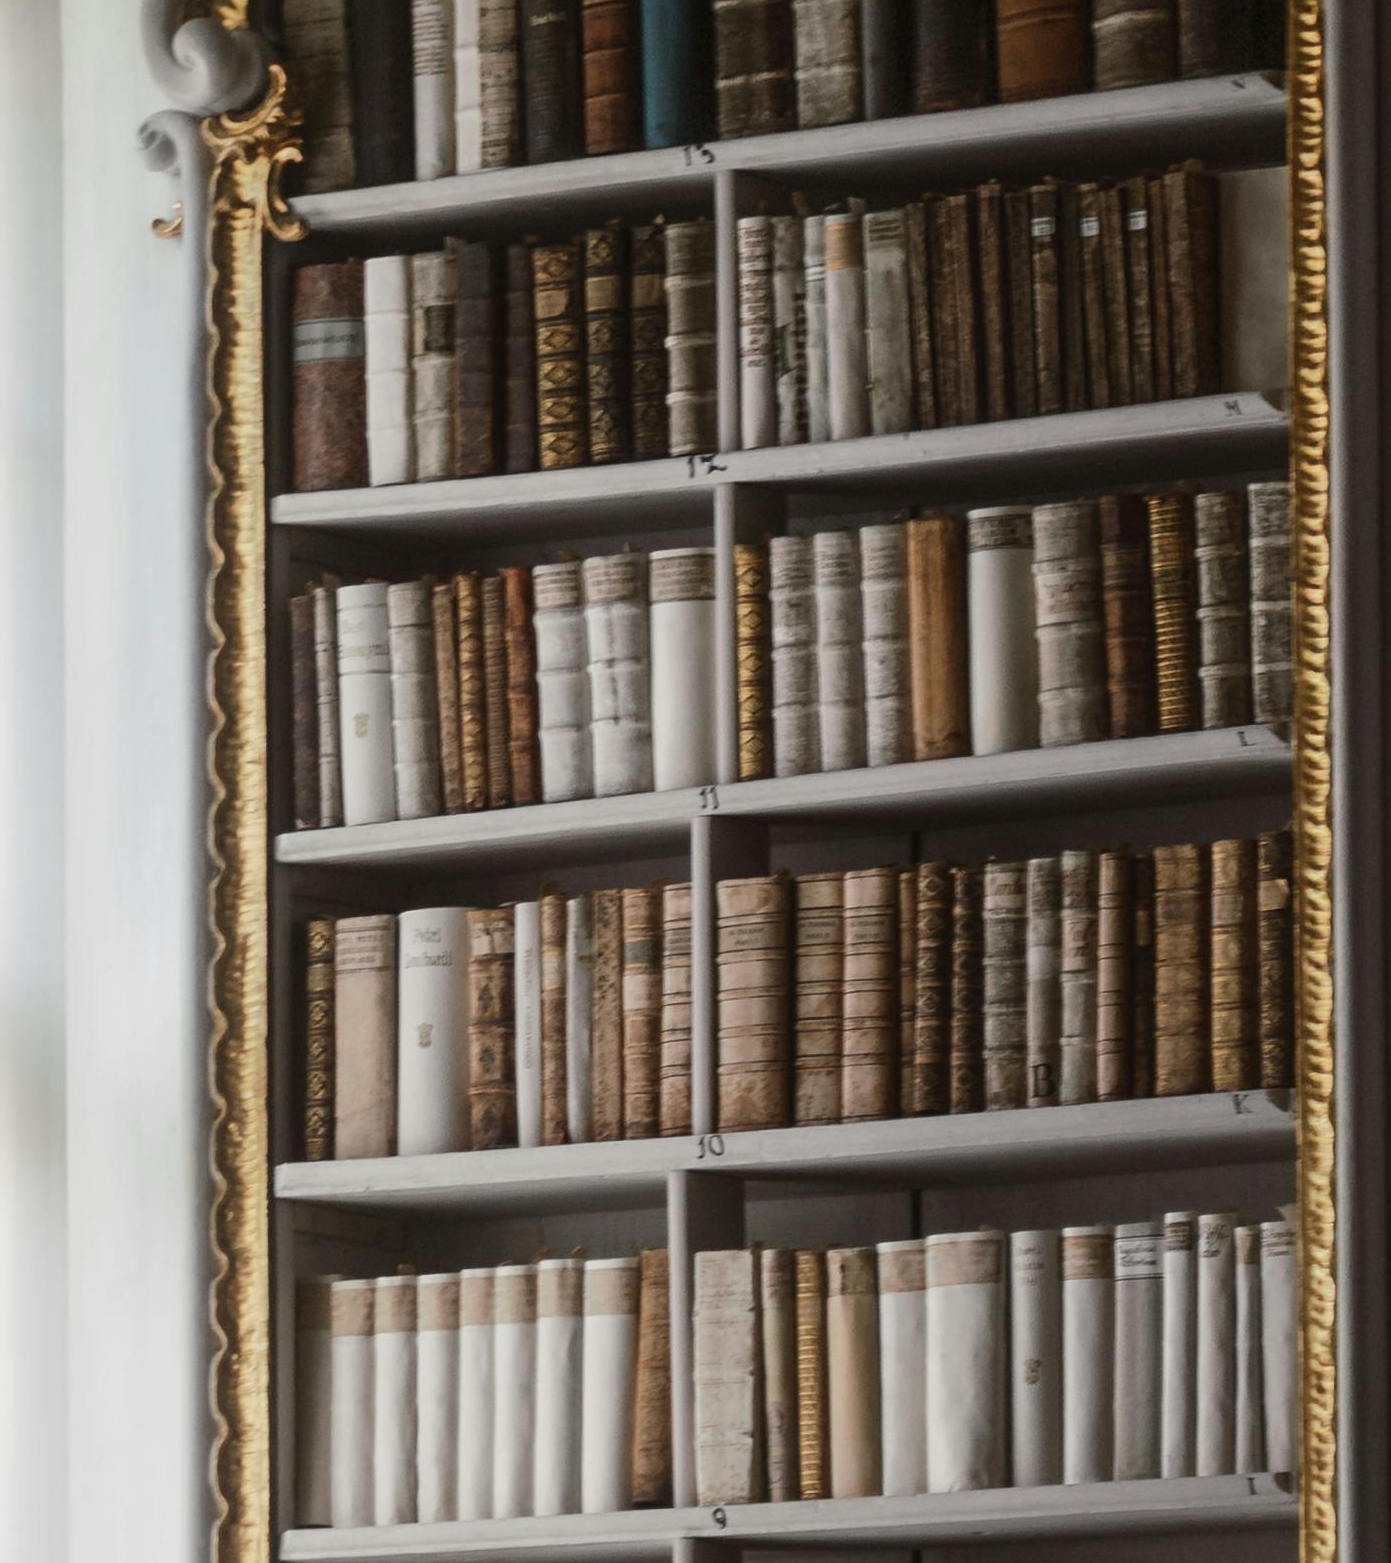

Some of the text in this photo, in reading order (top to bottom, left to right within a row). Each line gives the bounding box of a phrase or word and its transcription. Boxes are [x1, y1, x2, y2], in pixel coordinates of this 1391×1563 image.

[1223, 399, 1244, 417] M
[1237, 730, 1257, 747] L
[698, 785, 720, 811] 11
[1030, 1062, 1055, 1099] B
[1231, 1093, 1254, 1115] K
[697, 1133, 726, 1160] 10
[711, 1506, 728, 1530] 9
